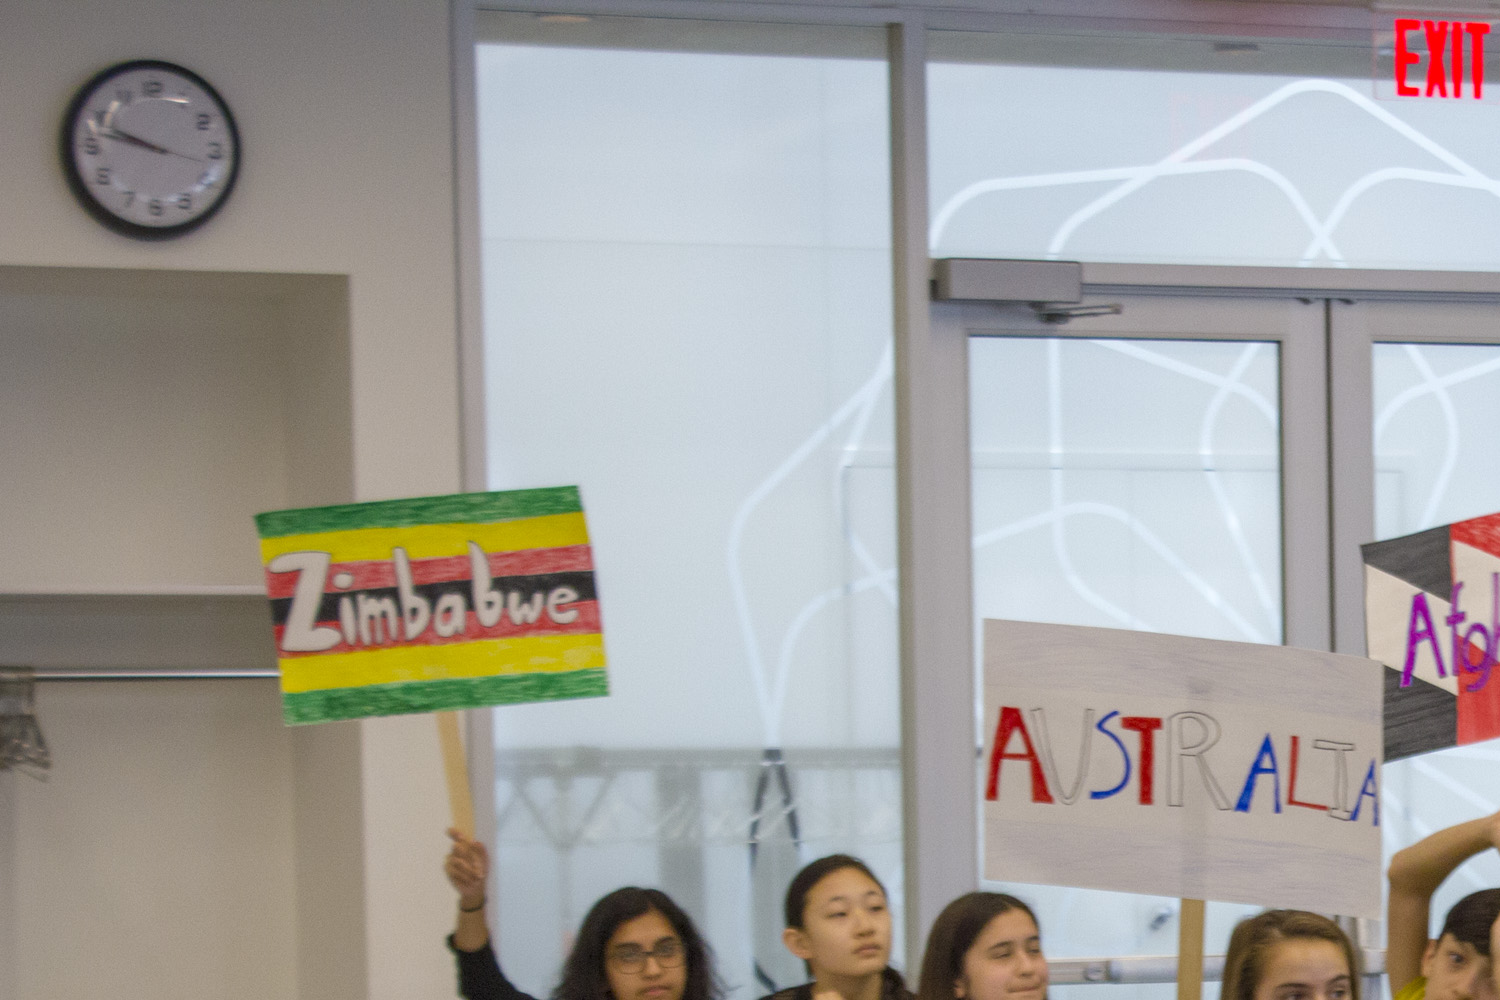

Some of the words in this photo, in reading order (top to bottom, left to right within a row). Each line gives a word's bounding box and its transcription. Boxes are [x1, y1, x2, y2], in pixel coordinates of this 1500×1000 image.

[1394, 18, 1491, 100] EXIT
[268, 540, 580, 652] Zimbabwe
[985, 706, 1381, 827] AUSTRALIA
